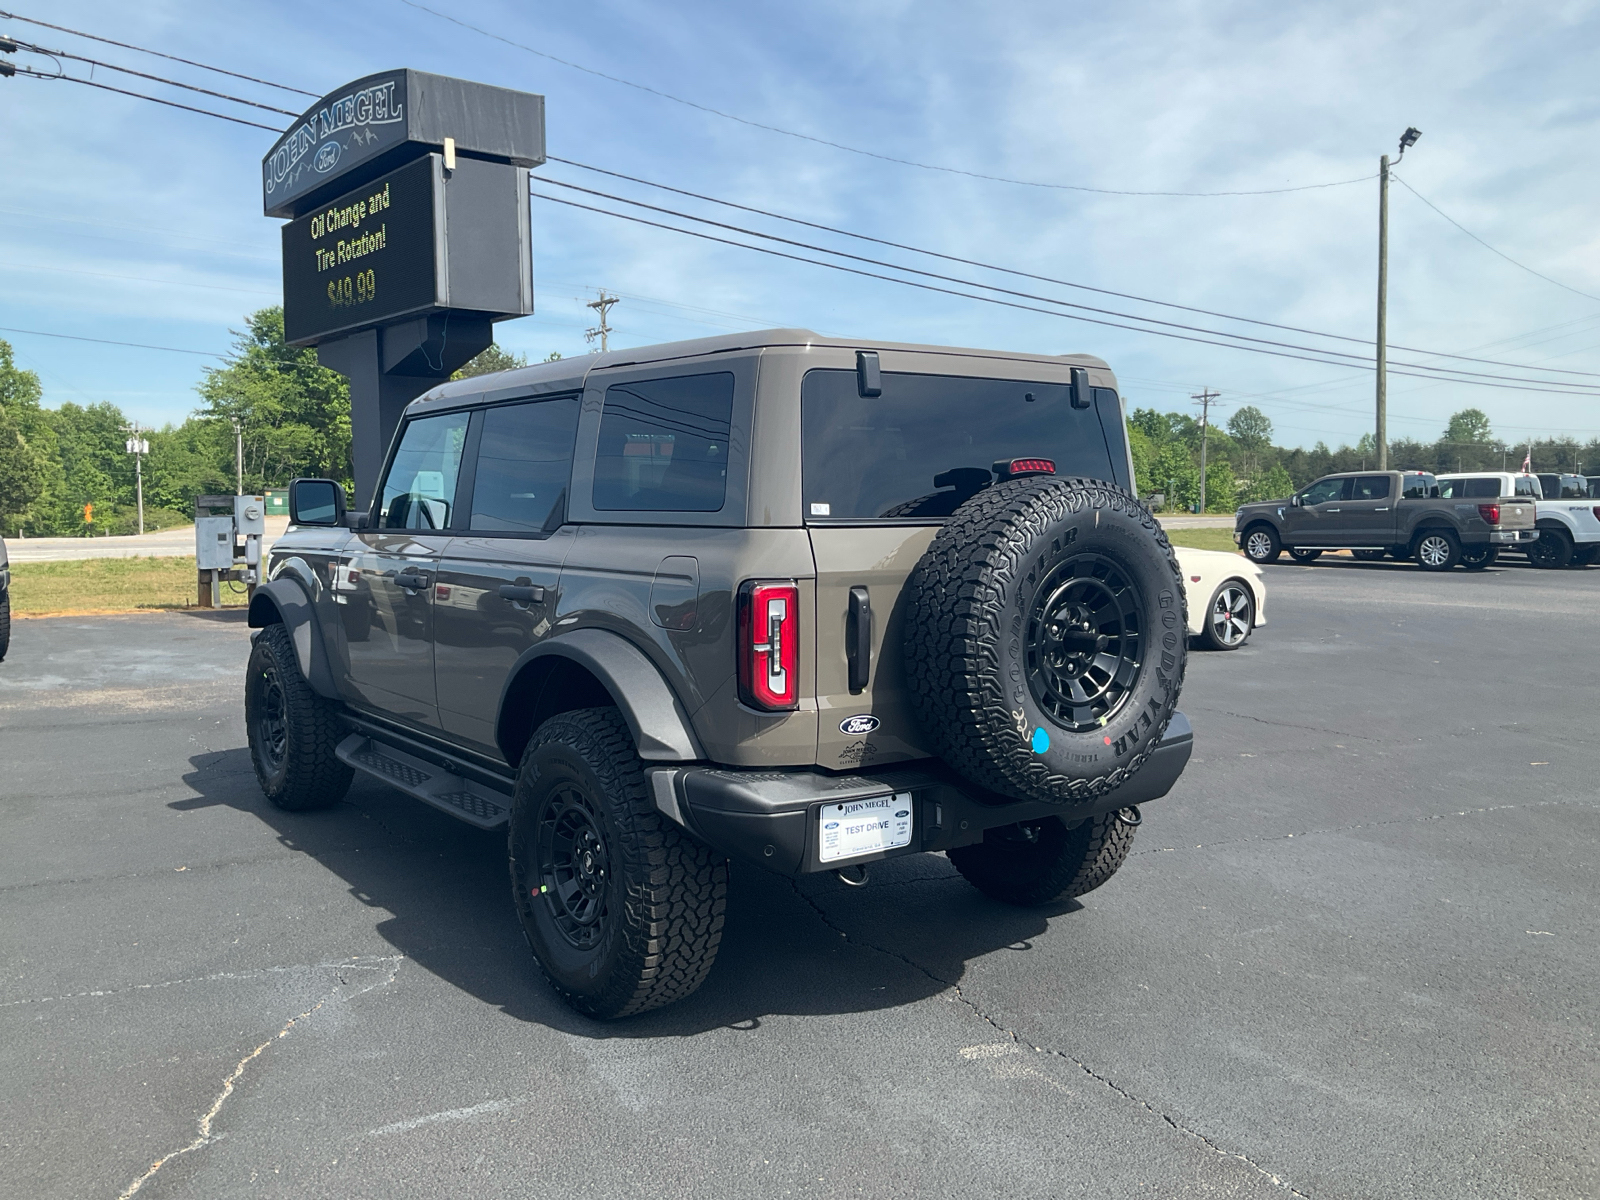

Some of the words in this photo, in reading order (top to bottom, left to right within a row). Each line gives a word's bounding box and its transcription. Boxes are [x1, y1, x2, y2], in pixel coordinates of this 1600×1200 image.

[266, 114, 317, 194] JOHN
[320, 81, 403, 140] MEGEL
[318, 146, 336, 170] Ford
[311, 213, 325, 240] Oil
[326, 200, 366, 233] Change
[368, 182, 390, 215] and
[315, 248, 336, 273] Tire
[337, 223, 386, 265] Rotation!
[327, 268, 375, 308] $49.99
[847, 718, 873, 732] Ford
[843, 802, 864, 816] JOHN
[865, 799, 891, 809] MEGEL
[845, 824, 865, 835] TEST
[866, 820, 890, 832] DRIVE
